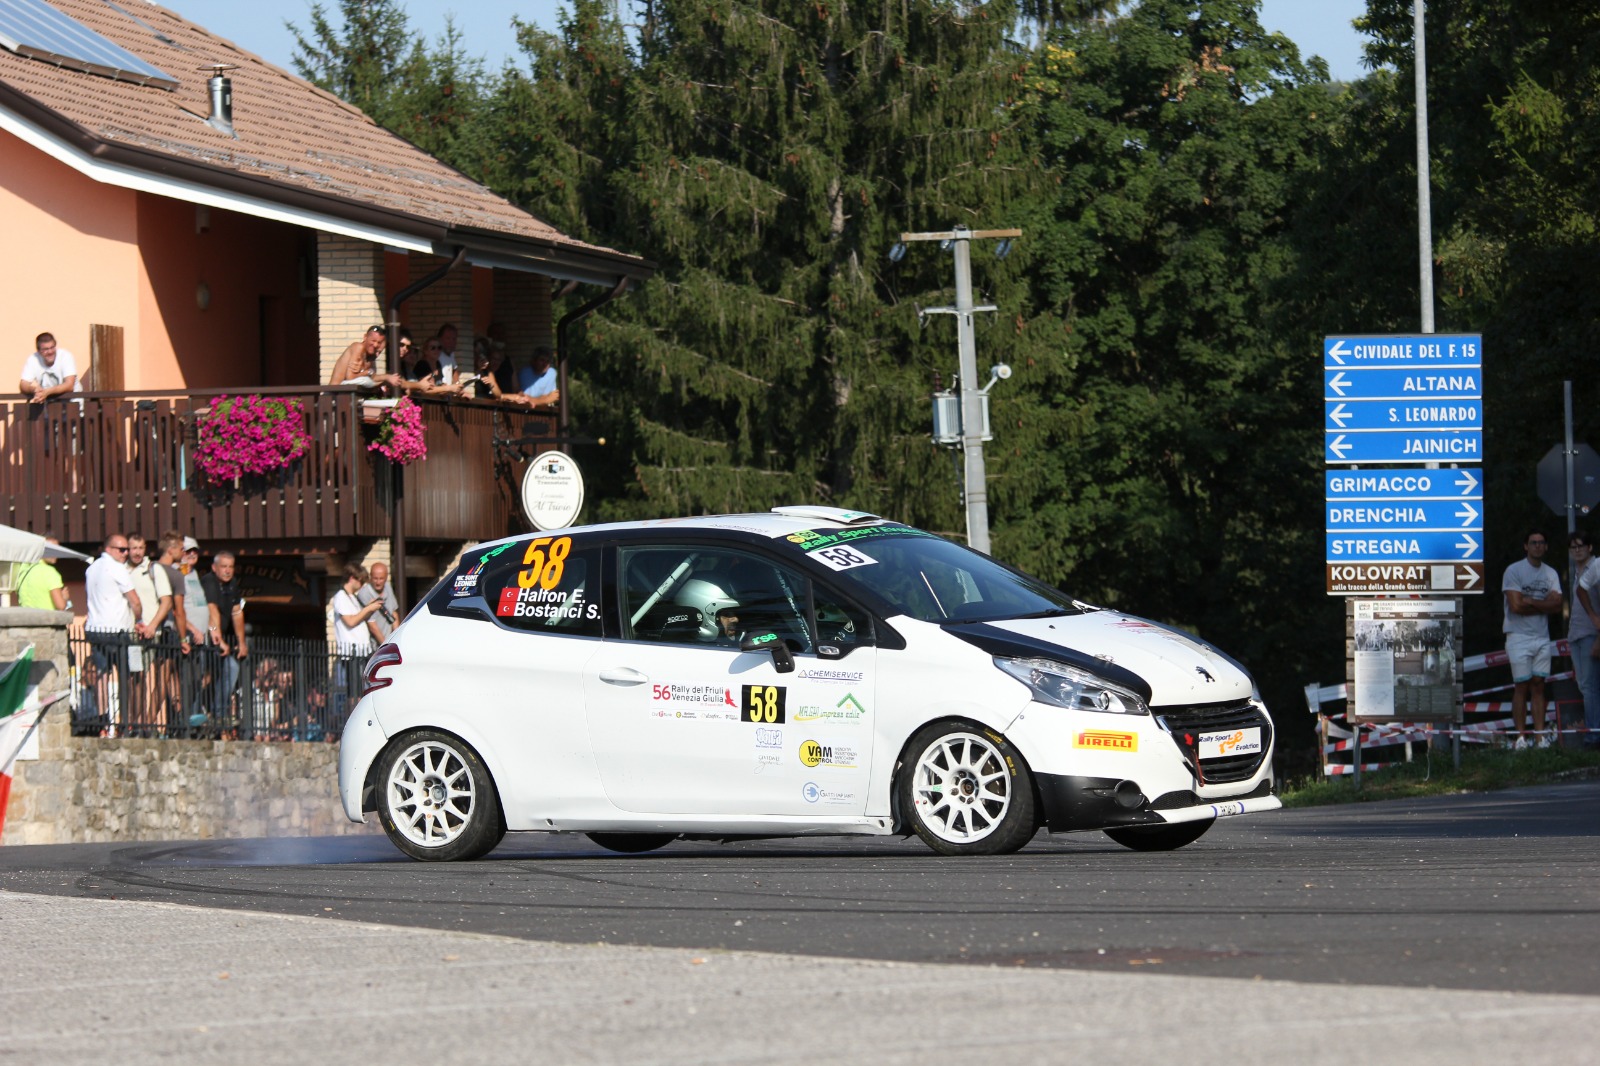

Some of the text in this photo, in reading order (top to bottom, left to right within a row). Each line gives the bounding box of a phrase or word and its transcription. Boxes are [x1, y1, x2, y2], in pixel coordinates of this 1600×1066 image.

[1353, 343, 1476, 359] CIVIDALE DEL F. 15
[1403, 376, 1477, 391] ALTANA
[1388, 407, 1477, 423] S. LEONARDO
[1402, 438, 1477, 454] JAINICH
[1329, 476, 1432, 493] GRIMACCO
[1329, 508, 1427, 523] DRENCHIA
[799, 534, 839, 551] Rally
[838, 526, 880, 538] Sport
[1331, 539, 1421, 555] STREGNA
[517, 536, 573, 591] 58
[818, 547, 865, 567] 58
[1331, 566, 1427, 581] KOLOVRAT
[1368, 583, 1384, 591] della
[1384, 583, 1406, 591] Grande
[1406, 583, 1427, 591] Guerra
[517, 588, 586, 604] Halfon E.
[513, 602, 601, 620] Bostanci S.
[667, 614, 689, 624] sparco
[751, 633, 778, 646] rse
[808, 669, 864, 680] CHEMISERVICE
[653, 684, 724, 701] 56 Rally del Friuli
[671, 693, 724, 703] Venezia Giulia
[749, 685, 778, 723] 58
[1078, 732, 1133, 749] PIRELLI
[1198, 734, 1231, 743] Rally Sport
[807, 745, 833, 758] VAM
[1235, 743, 1260, 751] Evolution
